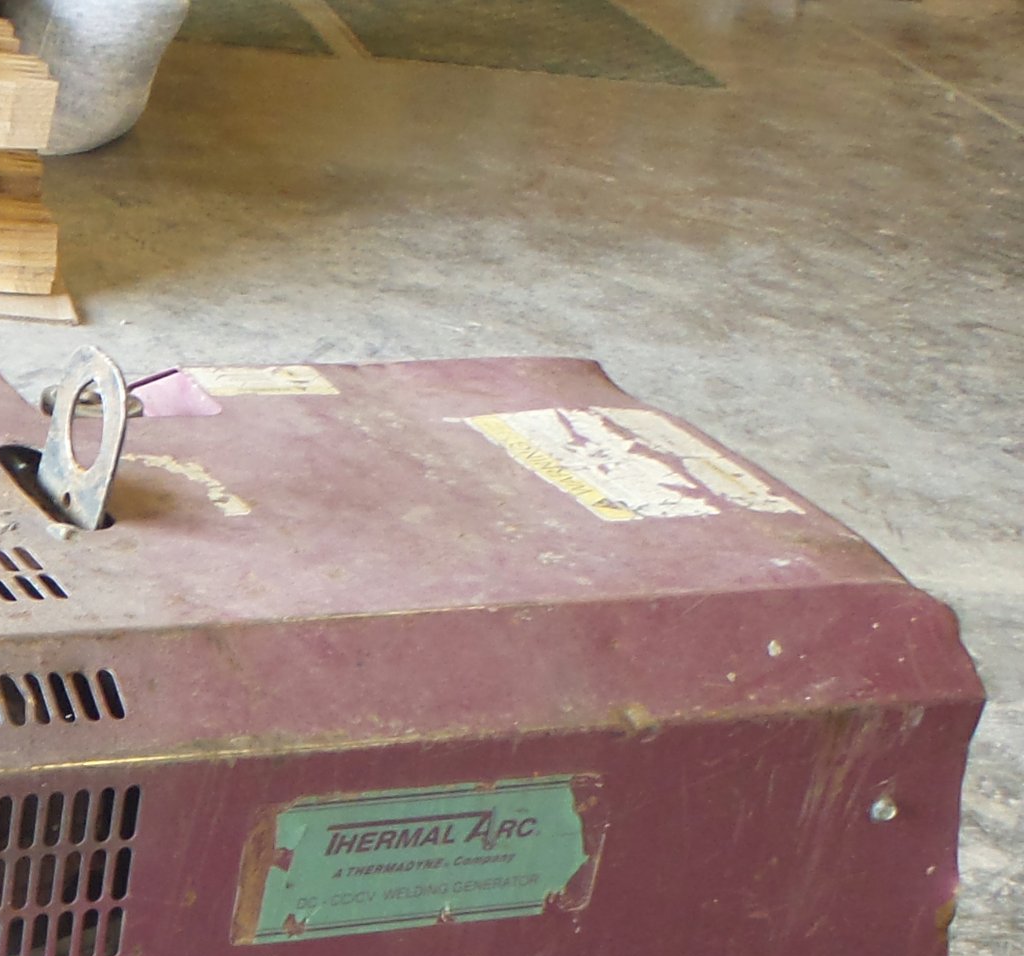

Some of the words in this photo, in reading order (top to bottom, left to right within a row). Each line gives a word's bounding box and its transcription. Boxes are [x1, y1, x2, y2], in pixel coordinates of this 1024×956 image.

[325, 817, 456, 856] THERMAL
[463, 810, 537, 846] ARC
[331, 868, 343, 879] A
[453, 852, 516, 868] Company
[297, 896, 317, 910] DC
[383, 880, 448, 900] WELDING
[452, 872, 541, 894] GENERATOR
